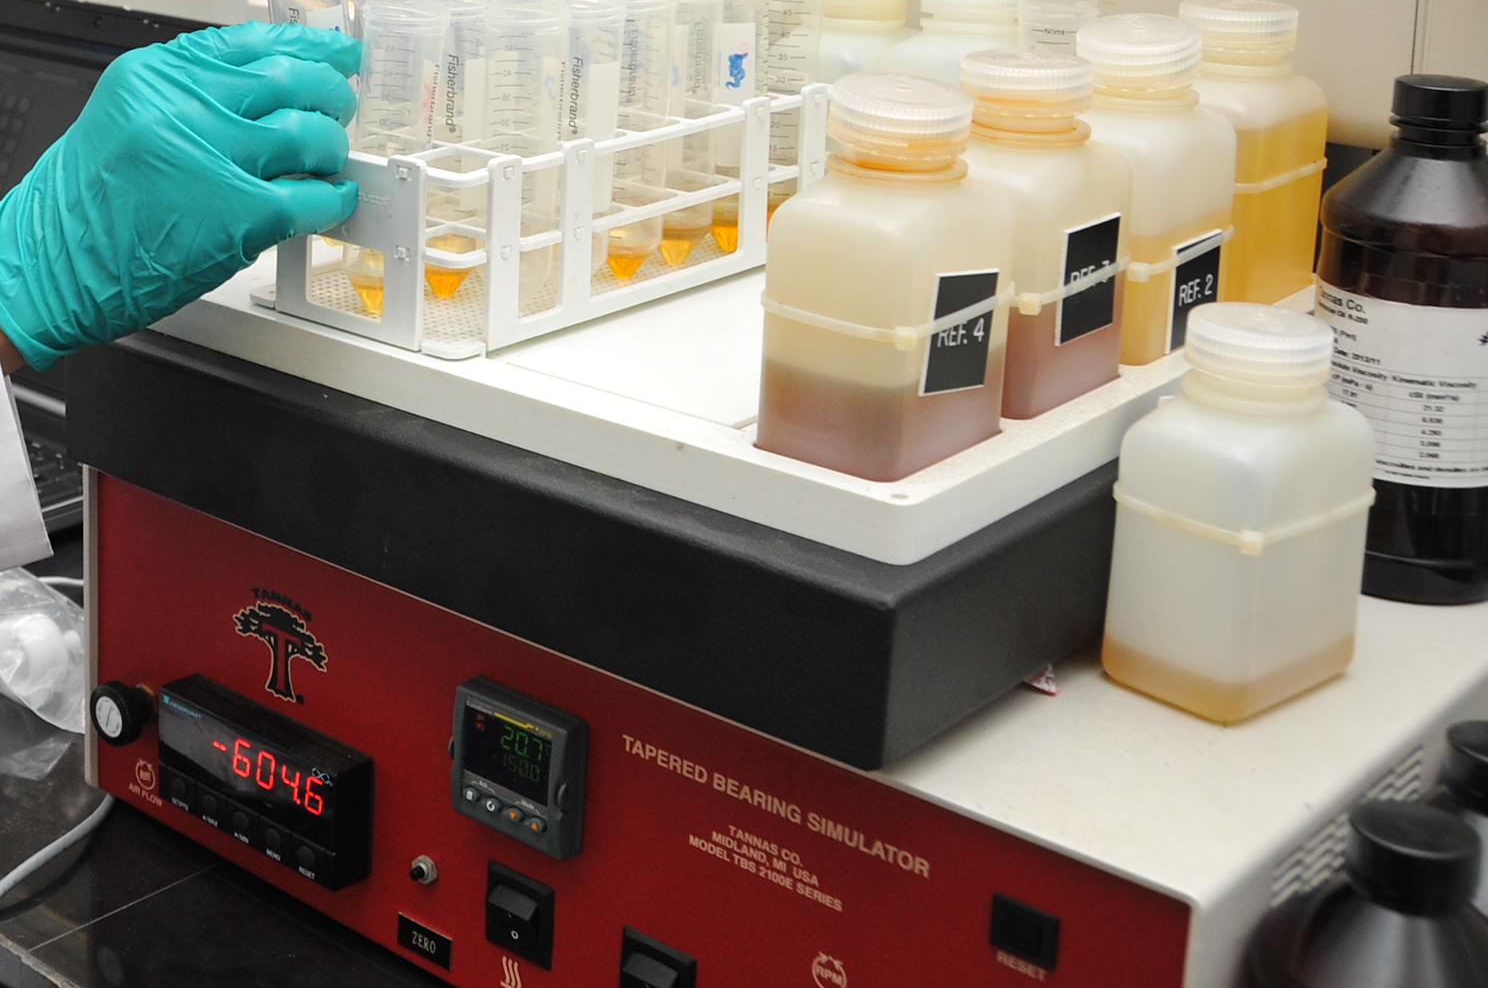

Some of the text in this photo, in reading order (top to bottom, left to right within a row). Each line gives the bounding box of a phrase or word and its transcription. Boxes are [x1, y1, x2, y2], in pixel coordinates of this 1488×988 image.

[1179, 273, 1214, 307] REF. 2
[1346, 299, 1366, 314] Co.
[973, 317, 985, 342] 4
[128, 782, 164, 808] AIR FLOW
[622, 734, 931, 880] TAPERED BEARING SIMULATOR
[266, 848, 281, 862] MENU
[711, 830, 820, 888] MIDLAND, MI USA
[728, 824, 804, 868] TANNAS CO.
[688, 834, 843, 913] MODEL TBS 2100E SERIES
[412, 930, 437, 955] ZERO
[815, 964, 844, 986] RPM
[996, 950, 1048, 982] RESET
